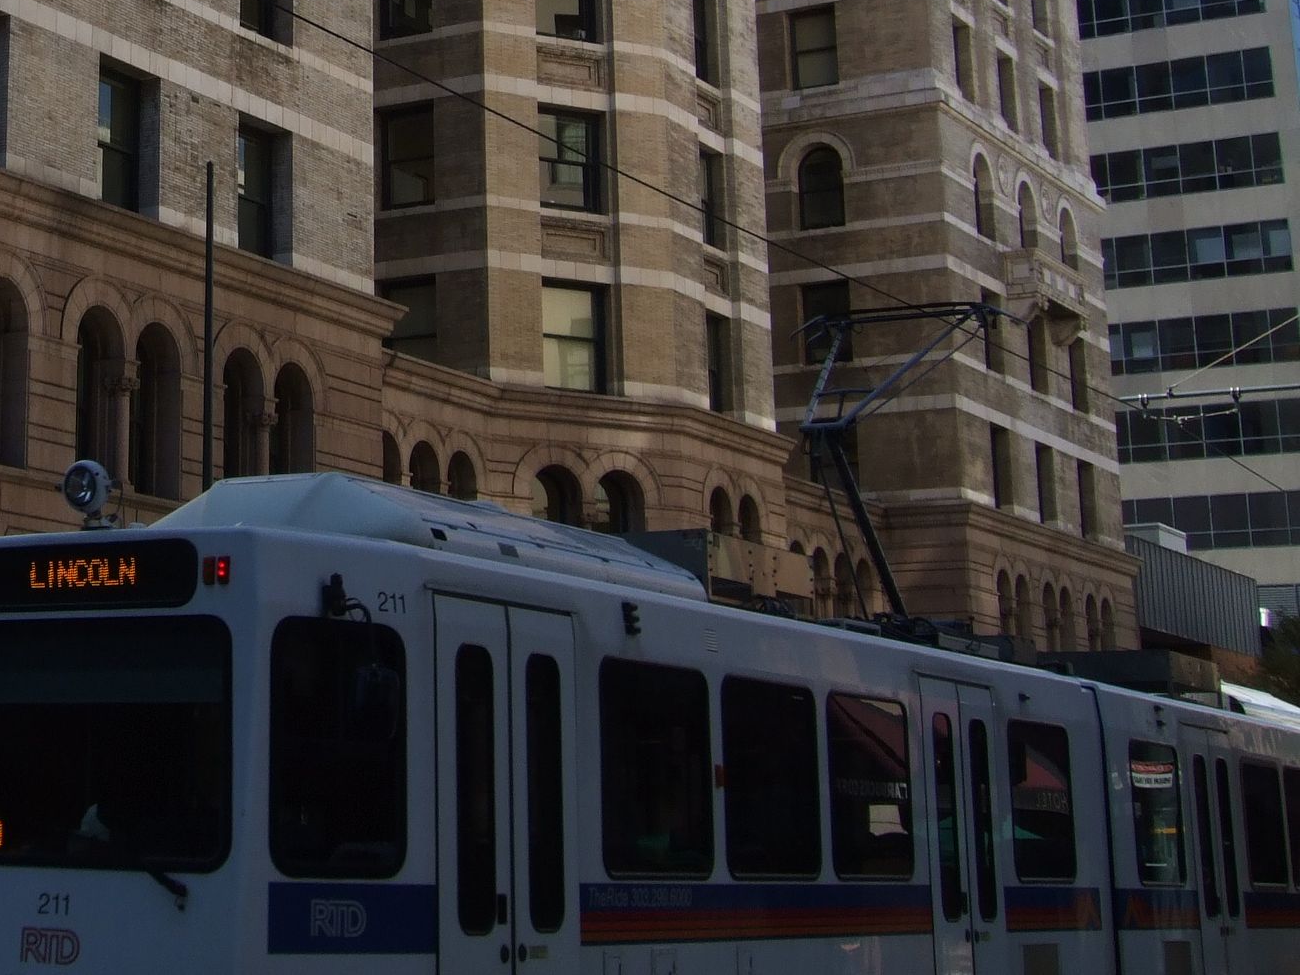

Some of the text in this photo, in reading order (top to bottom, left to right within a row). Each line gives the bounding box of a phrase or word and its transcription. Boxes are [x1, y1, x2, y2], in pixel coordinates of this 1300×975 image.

[30, 557, 136, 588] LINCOLN
[377, 591, 406, 614] 211
[37, 892, 71, 916] 211
[310, 899, 367, 937] RTD
[20, 927, 80, 965] RTD
